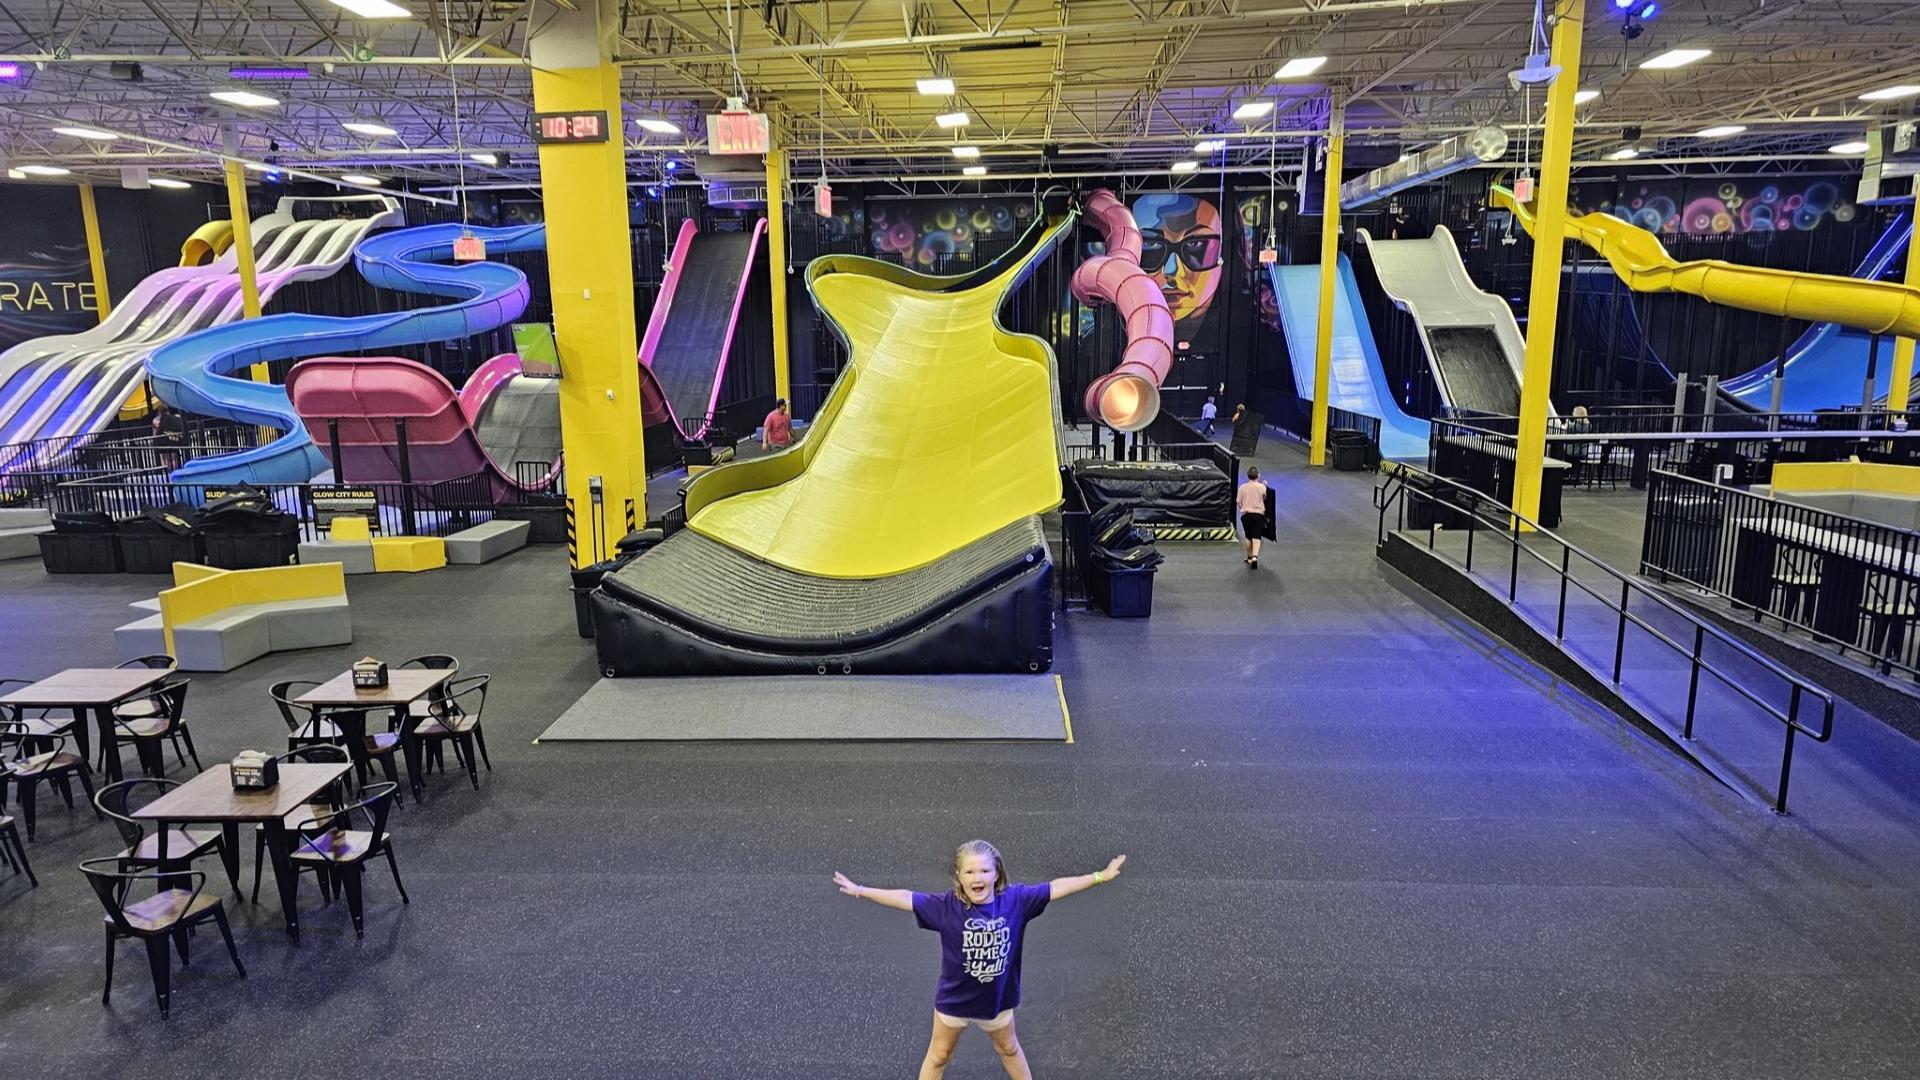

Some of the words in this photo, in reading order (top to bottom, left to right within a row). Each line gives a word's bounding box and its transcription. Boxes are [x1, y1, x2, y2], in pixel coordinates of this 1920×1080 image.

[549, 116, 599, 137] 10:24
[962, 926, 1010, 947] RODEO
[962, 946, 999, 960] TIME
